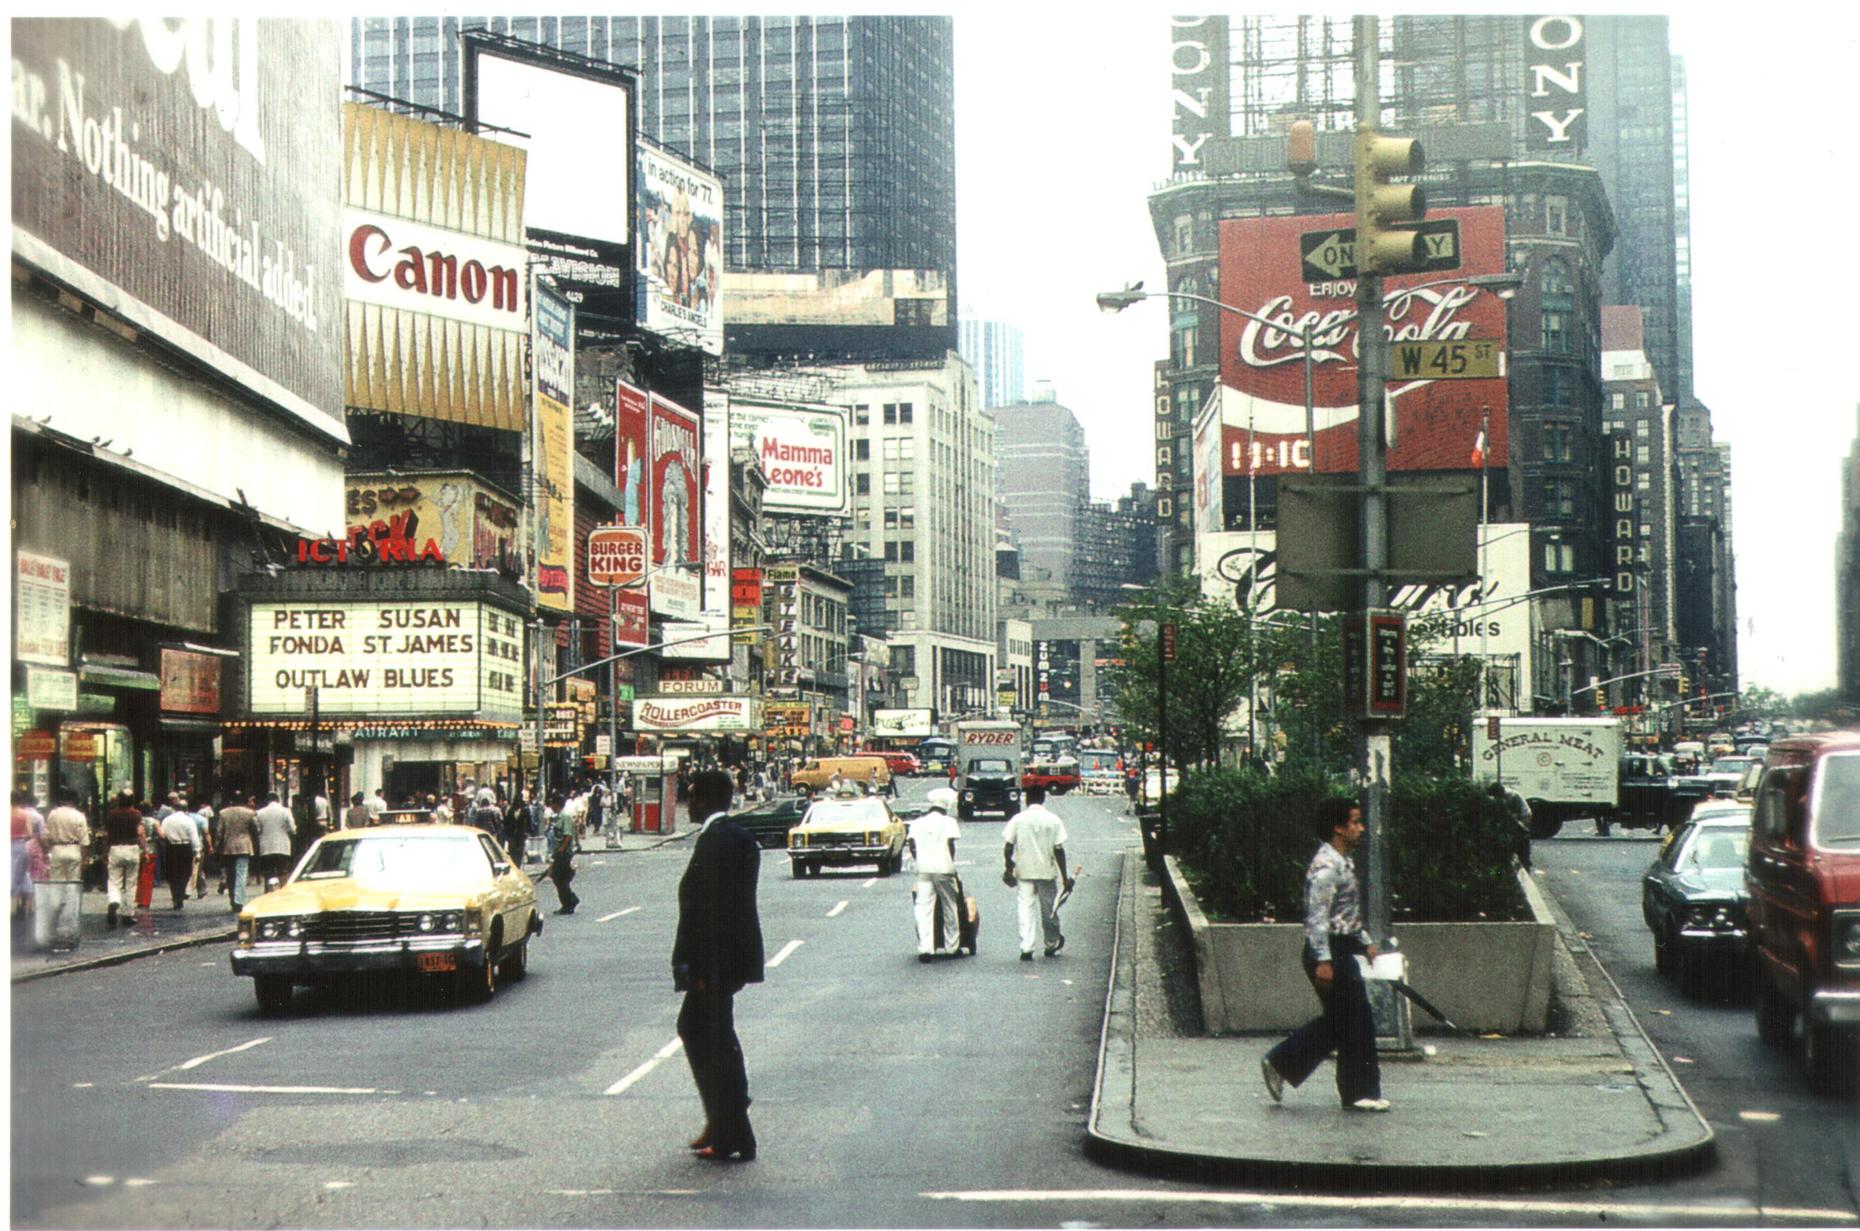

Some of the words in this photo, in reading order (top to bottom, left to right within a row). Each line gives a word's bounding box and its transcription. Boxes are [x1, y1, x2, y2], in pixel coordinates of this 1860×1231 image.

[57, 58, 170, 242] Nothing
[174, 179, 261, 292] artificial
[262, 240, 317, 333] added
[1324, 244, 1356, 267] ON
[348, 223, 518, 313] Canon
[1402, 346, 1422, 375] W
[1430, 345, 1468, 375] 45
[1474, 344, 1492, 360] ST
[761, 436, 833, 465] Mamma
[1615, 439, 1634, 592] HOWARD
[591, 543, 643, 556] BURGER
[591, 556, 643, 573] KING
[273, 609, 346, 630] PETER
[378, 608, 461, 628] SUSAN
[269, 635, 345, 655] FONDA
[396, 634, 473, 654] JAMES
[782, 584, 796, 685] STEAKS
[275, 669, 370, 689] OUTLAW
[384, 668, 454, 689] BLUES
[662, 682, 720, 692] FORUM
[641, 700, 743, 721] ROLLERCOASTER
[966, 732, 1015, 745] RYDER
[1482, 732, 1553, 761] GENERAL
[1559, 733, 1604, 759] MEAT
